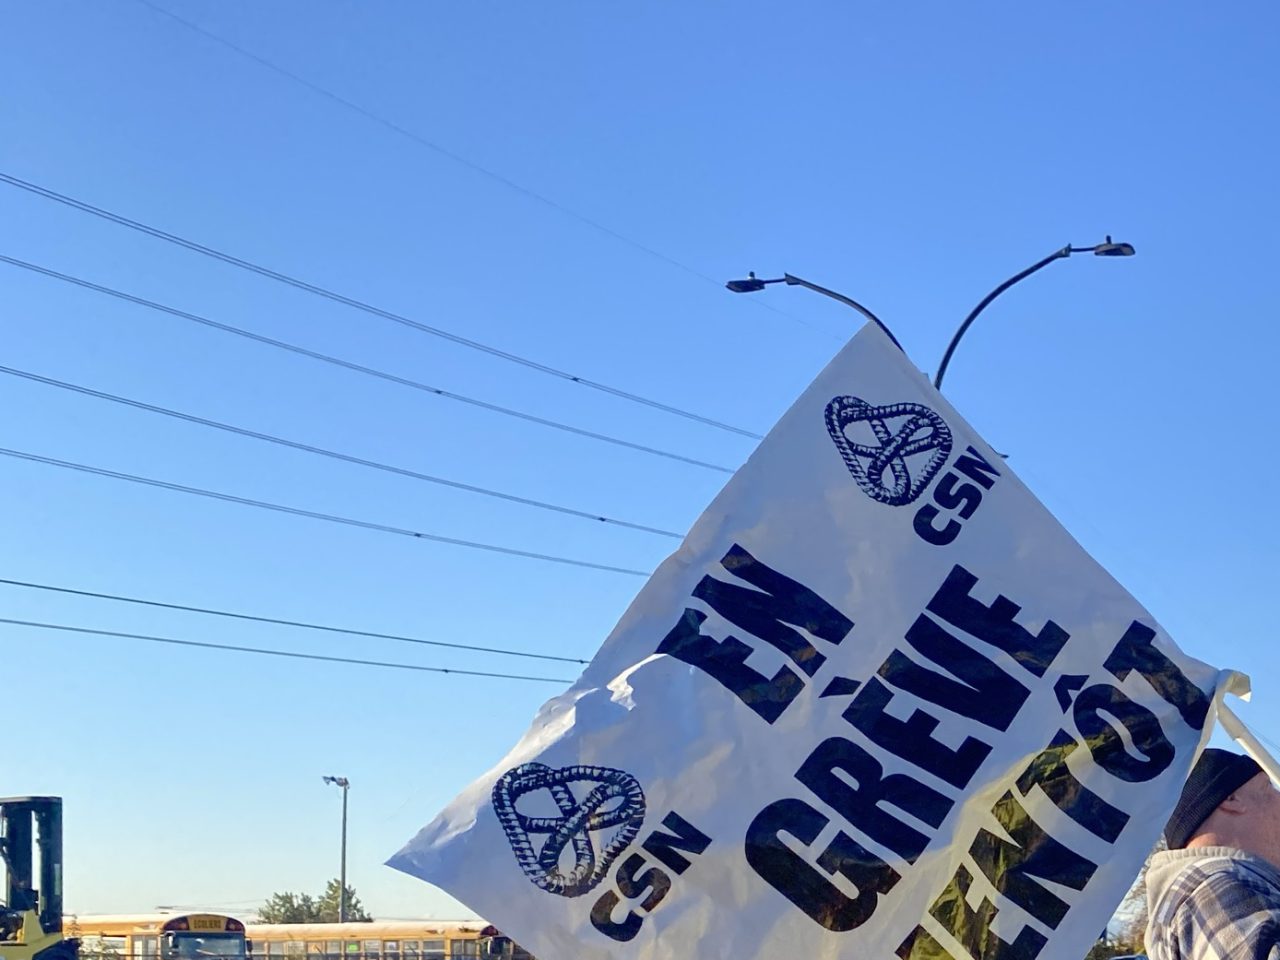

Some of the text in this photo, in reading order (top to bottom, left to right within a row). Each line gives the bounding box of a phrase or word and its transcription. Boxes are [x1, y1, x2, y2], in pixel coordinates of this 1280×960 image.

[913, 446, 1001, 545] CSN
[655, 543, 855, 724] EN
[745, 564, 1070, 931] GRÈVE
[589, 810, 712, 943] CSN
